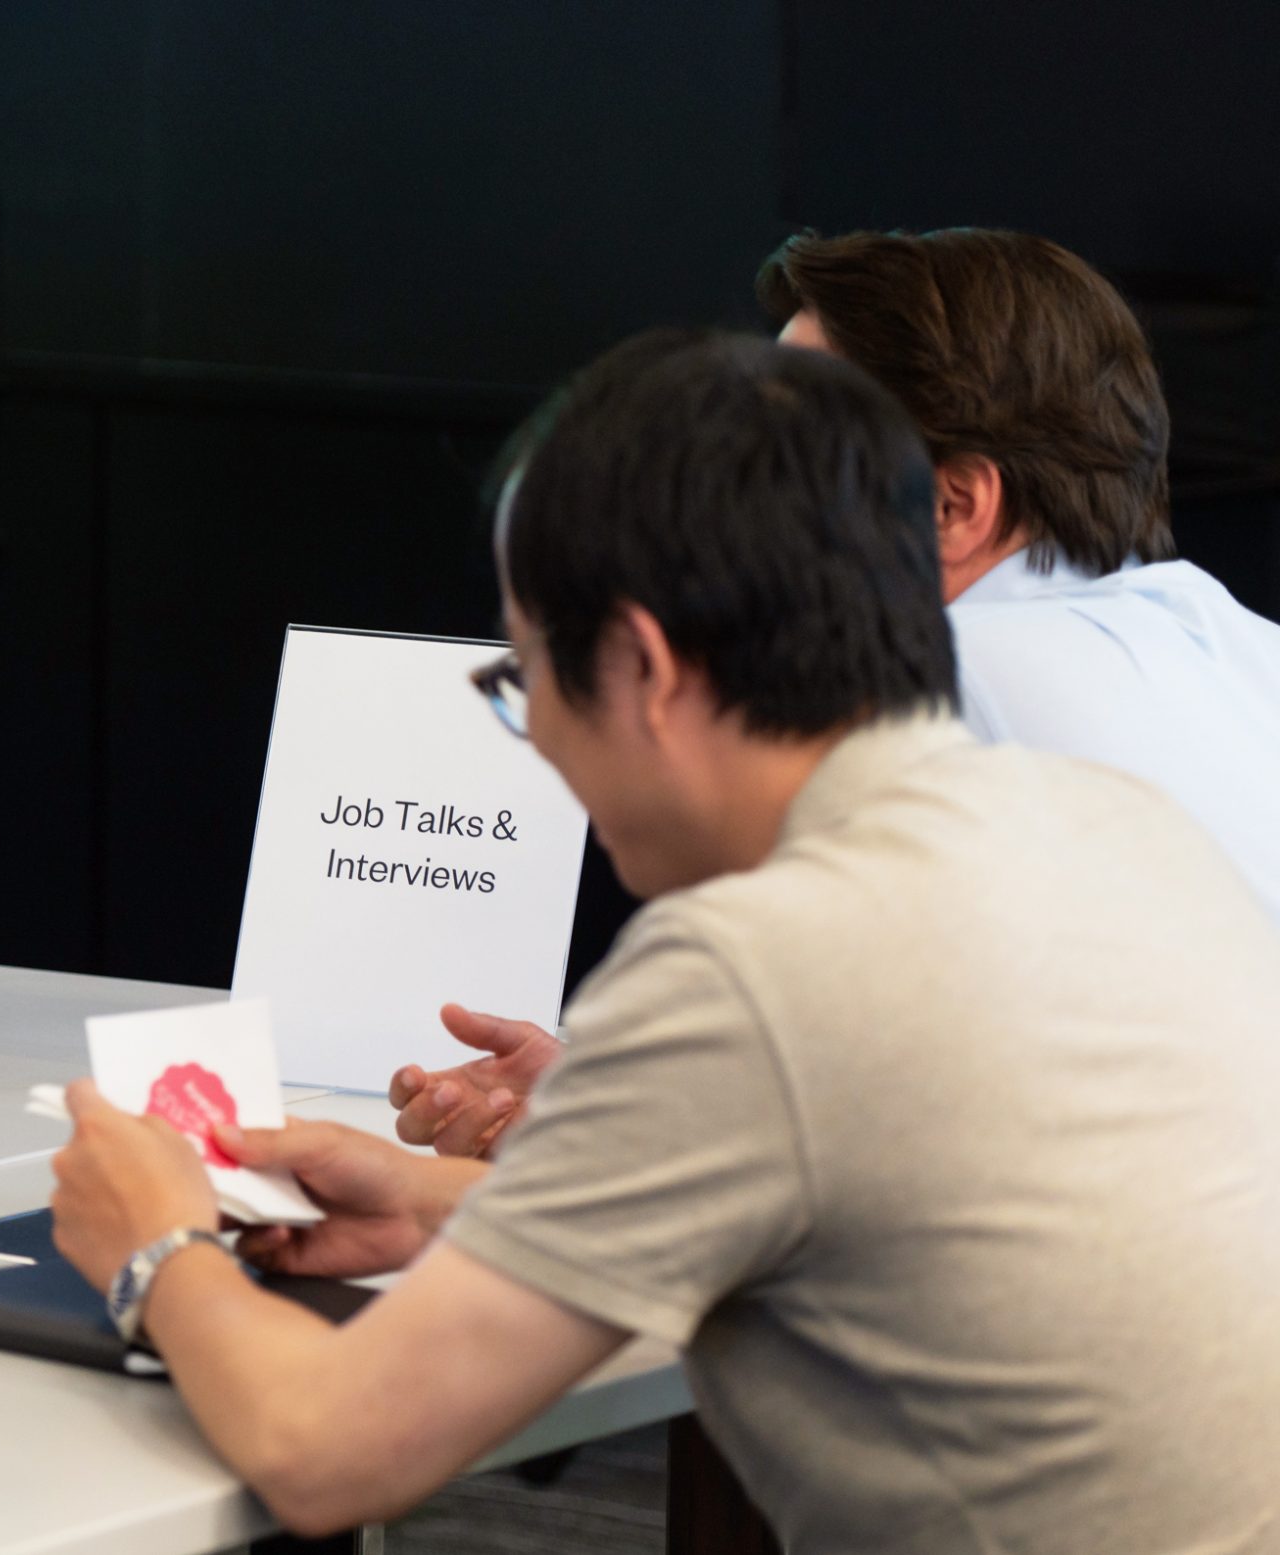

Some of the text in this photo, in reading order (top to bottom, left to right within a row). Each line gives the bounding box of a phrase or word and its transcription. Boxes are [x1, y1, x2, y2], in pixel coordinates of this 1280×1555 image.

[320, 795, 519, 842] Job Talks &
[326, 848, 496, 894] Interviews
